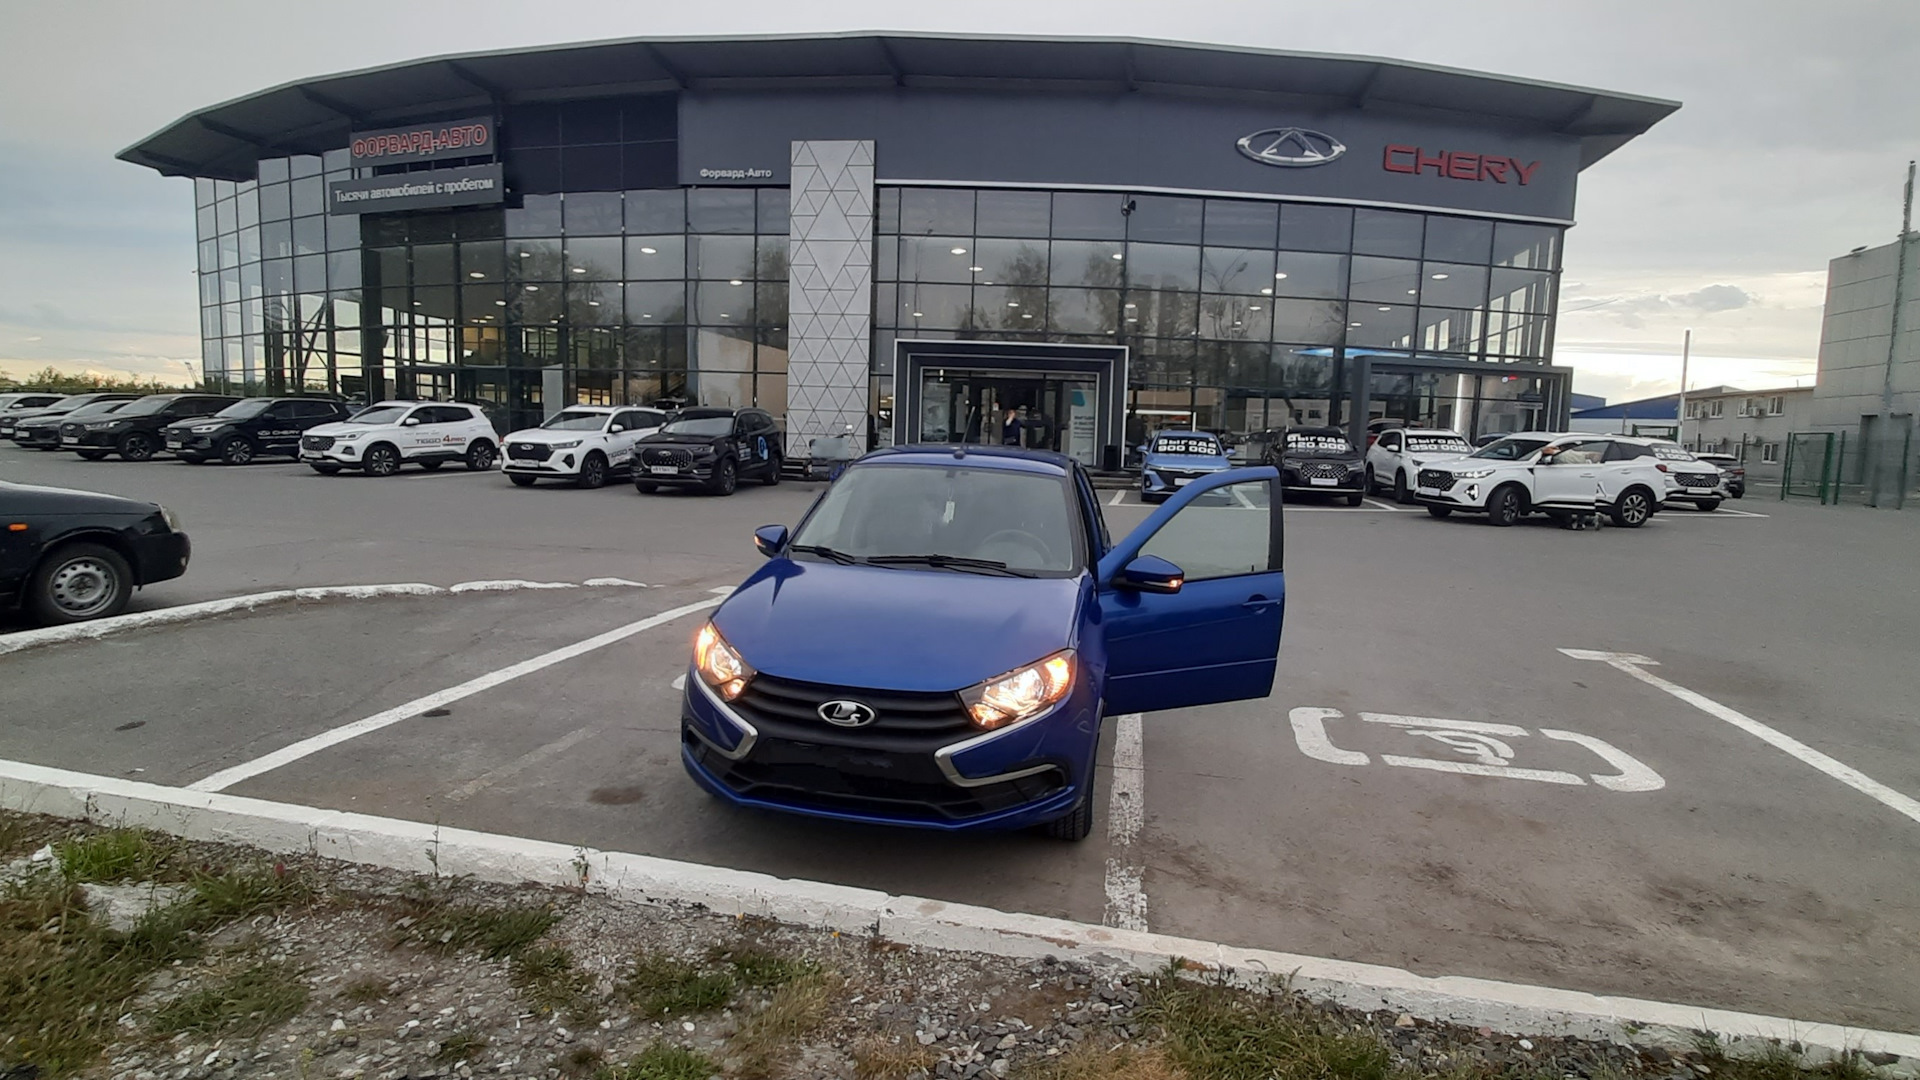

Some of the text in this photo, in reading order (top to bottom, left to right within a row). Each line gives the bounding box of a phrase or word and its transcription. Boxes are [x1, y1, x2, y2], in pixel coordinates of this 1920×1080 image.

[352, 123, 488, 158] ФОРВАРД-АВТО
[700, 168, 772, 180] Форвард-Авто
[1383, 143, 1540, 185] CHERY
[334, 178, 494, 202] Тысячи автомобилей с пробегом
